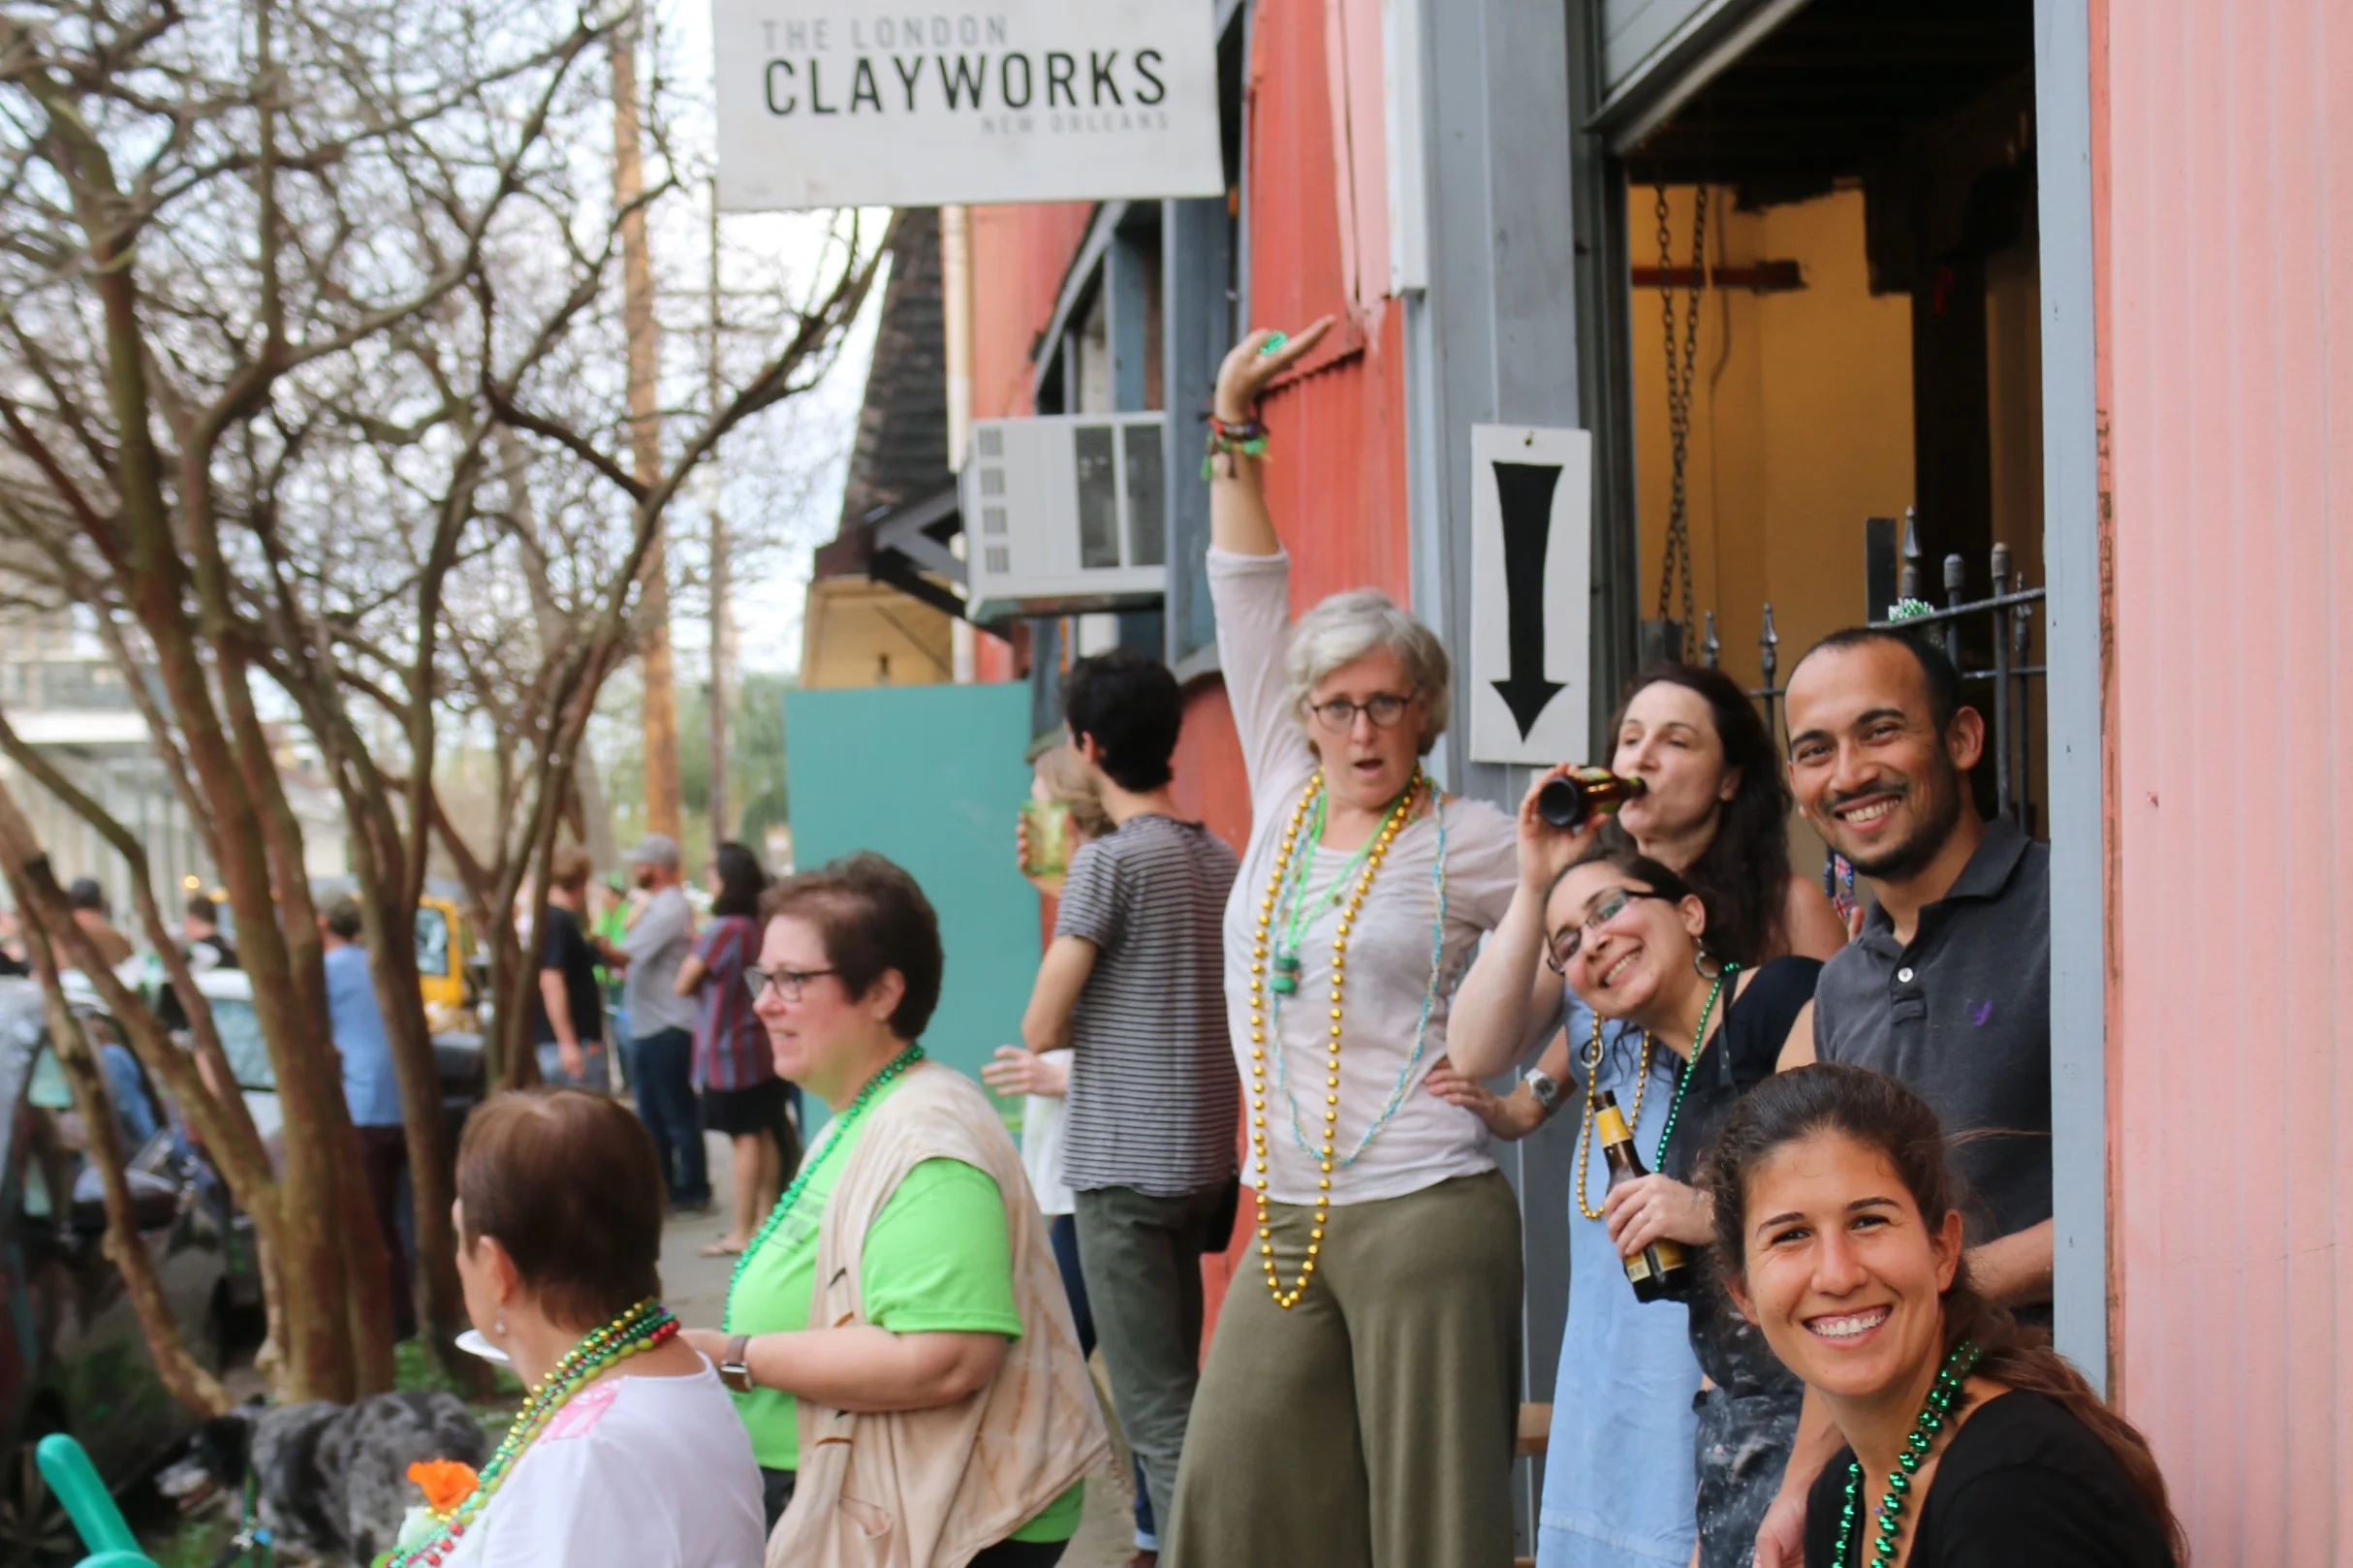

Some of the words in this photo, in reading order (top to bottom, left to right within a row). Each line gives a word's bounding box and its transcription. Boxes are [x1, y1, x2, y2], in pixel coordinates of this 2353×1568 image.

[762, 20, 830, 51] THE
[852, 16, 1009, 48] LONDON
[765, 49, 1167, 116] CLAYWORKS
[982, 114, 1035, 135] NEW
[1051, 111, 1170, 134] ORLEANS
